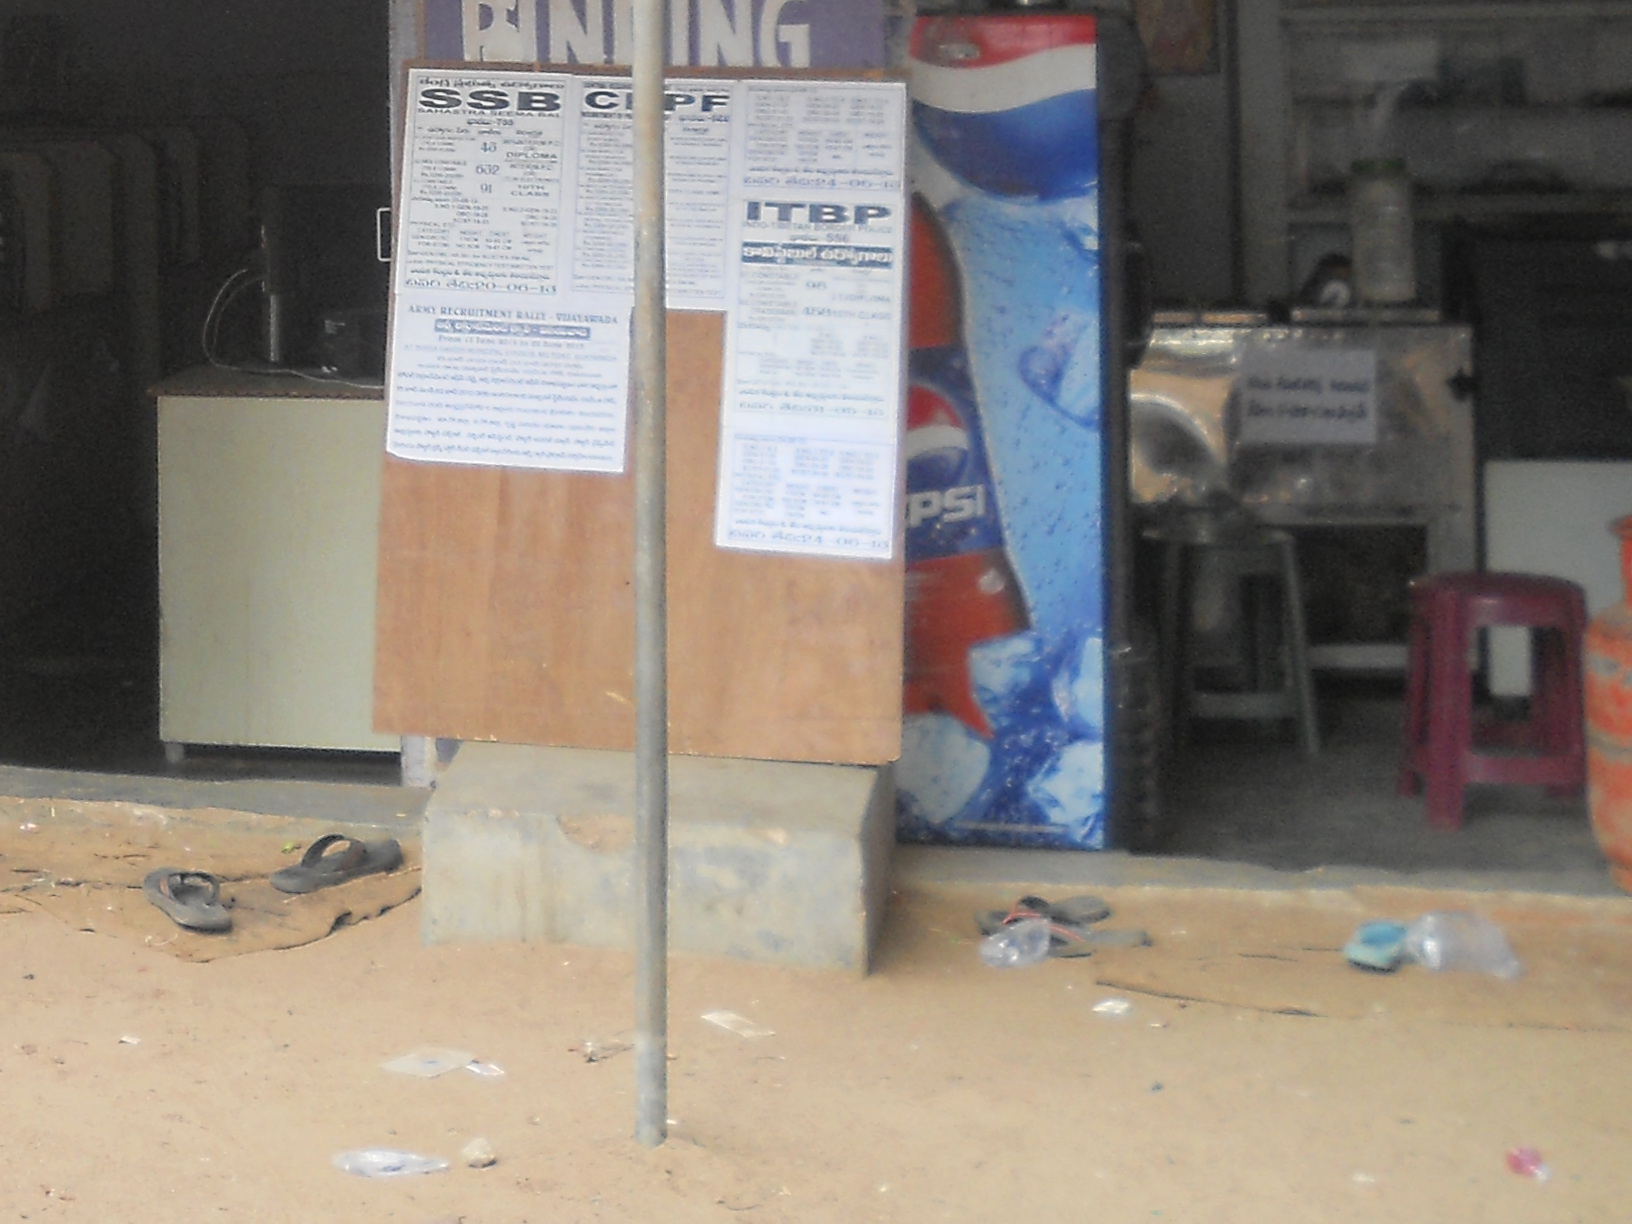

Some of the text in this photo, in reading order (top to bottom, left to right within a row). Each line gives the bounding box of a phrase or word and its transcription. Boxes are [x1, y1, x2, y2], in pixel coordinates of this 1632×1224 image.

[418, 88, 562, 112] SSB
[584, 90, 730, 112] CPF
[746, 201, 893, 225] ITBP
[408, 305, 436, 315] ARMY
[440, 306, 512, 319] RECRUITMENT
[905, 483, 988, 528] PSI
